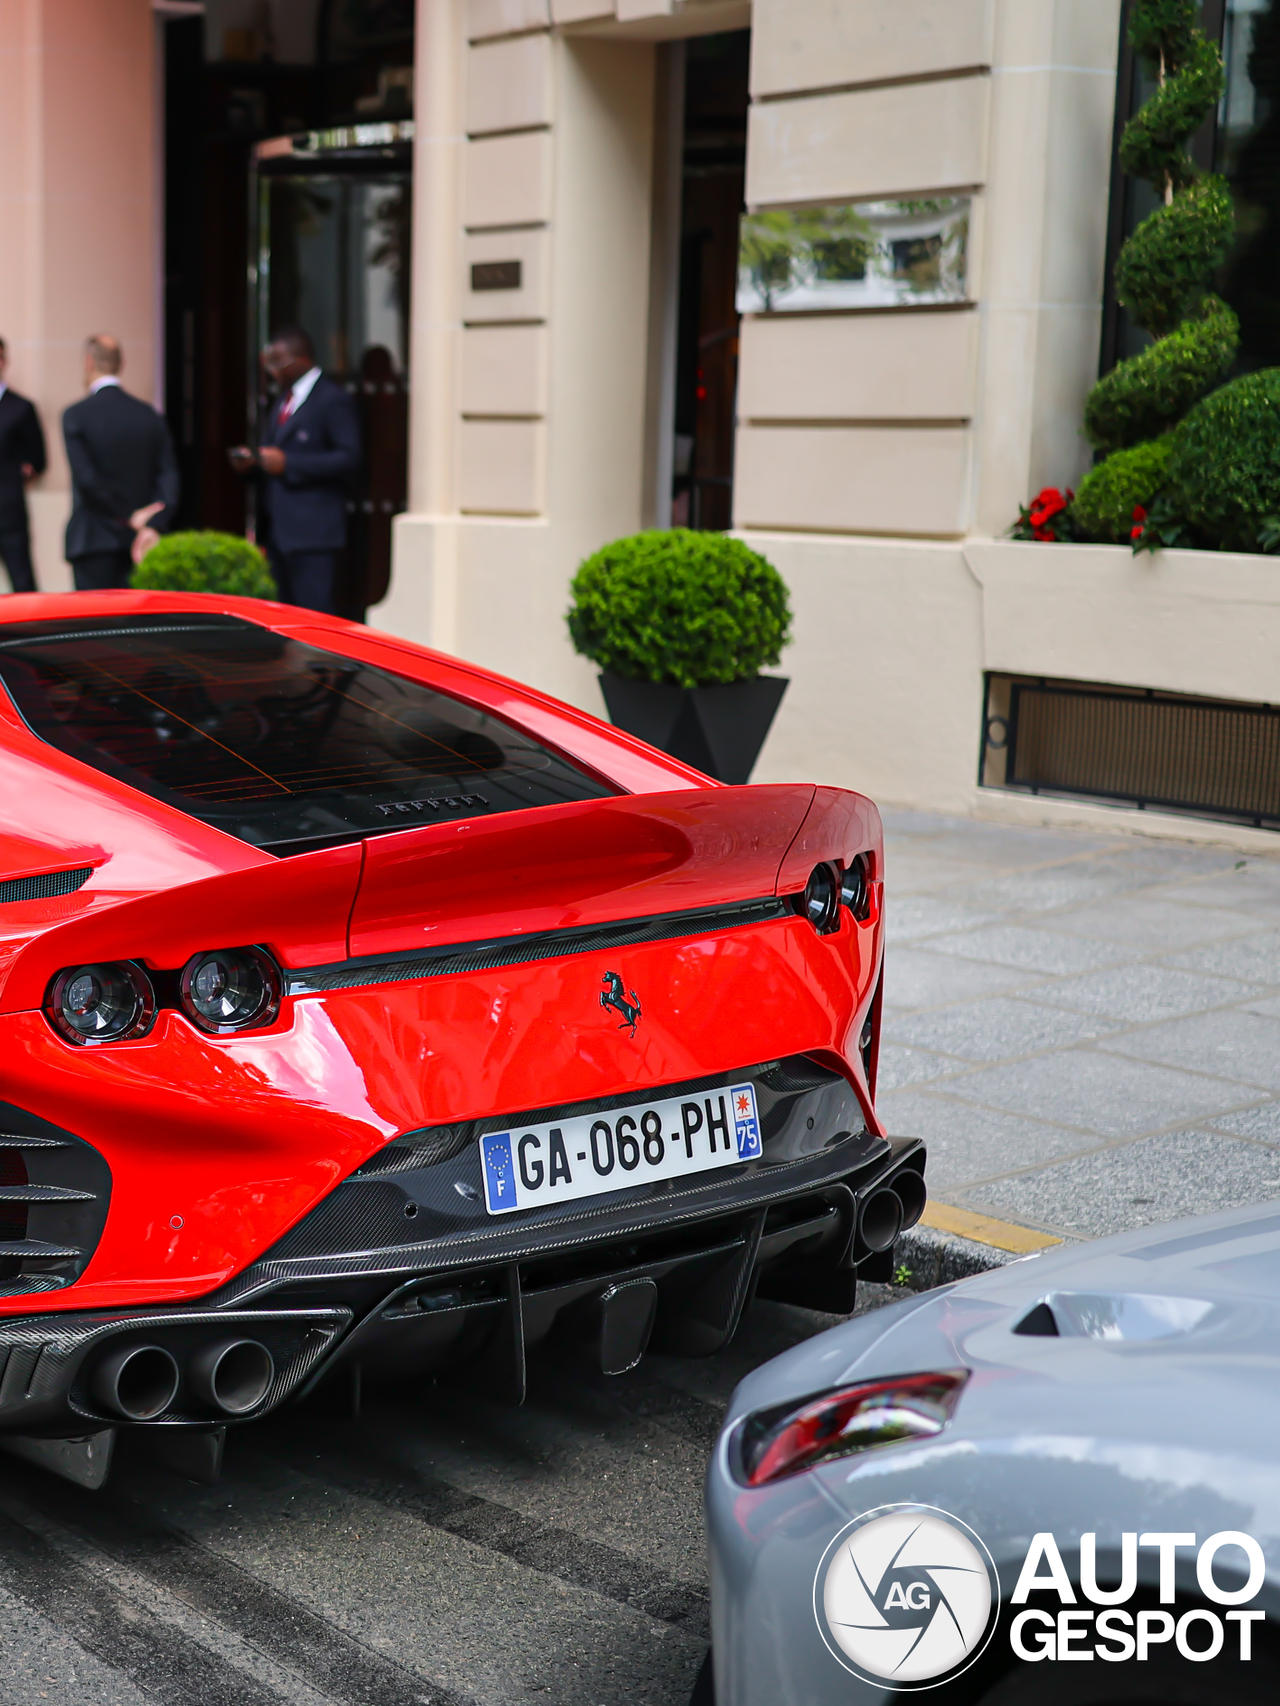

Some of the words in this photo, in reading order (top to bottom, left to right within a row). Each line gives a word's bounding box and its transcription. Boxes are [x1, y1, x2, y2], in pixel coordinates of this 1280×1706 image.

[375, 793, 490, 815] Ferrari
[496, 1180, 505, 1197] F
[518, 1095, 731, 1191] GA-068-PH
[737, 1124, 757, 1152] 75
